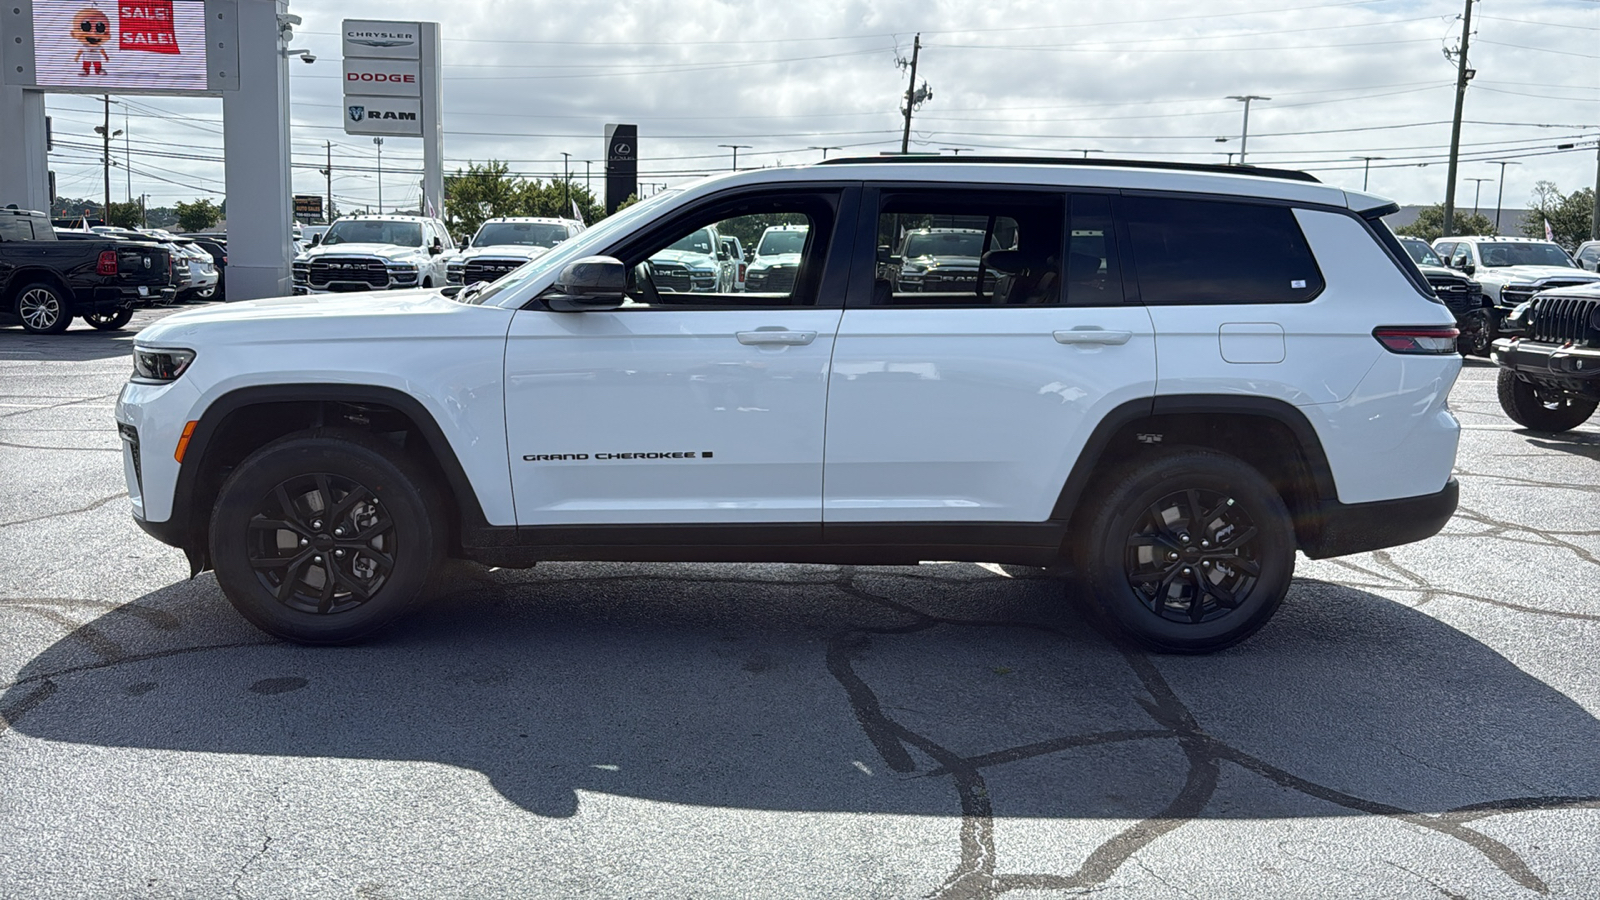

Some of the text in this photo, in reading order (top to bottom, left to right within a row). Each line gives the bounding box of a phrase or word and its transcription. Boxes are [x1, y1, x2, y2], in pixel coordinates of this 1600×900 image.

[121, 7, 170, 20] SALE!
[122, 32, 174, 44] SALE!
[347, 31, 413, 39] CHRYSLER
[347, 72, 416, 83] DODGE
[367, 110, 417, 121] RAM
[522, 451, 697, 462] GRAND CHEROKEE
